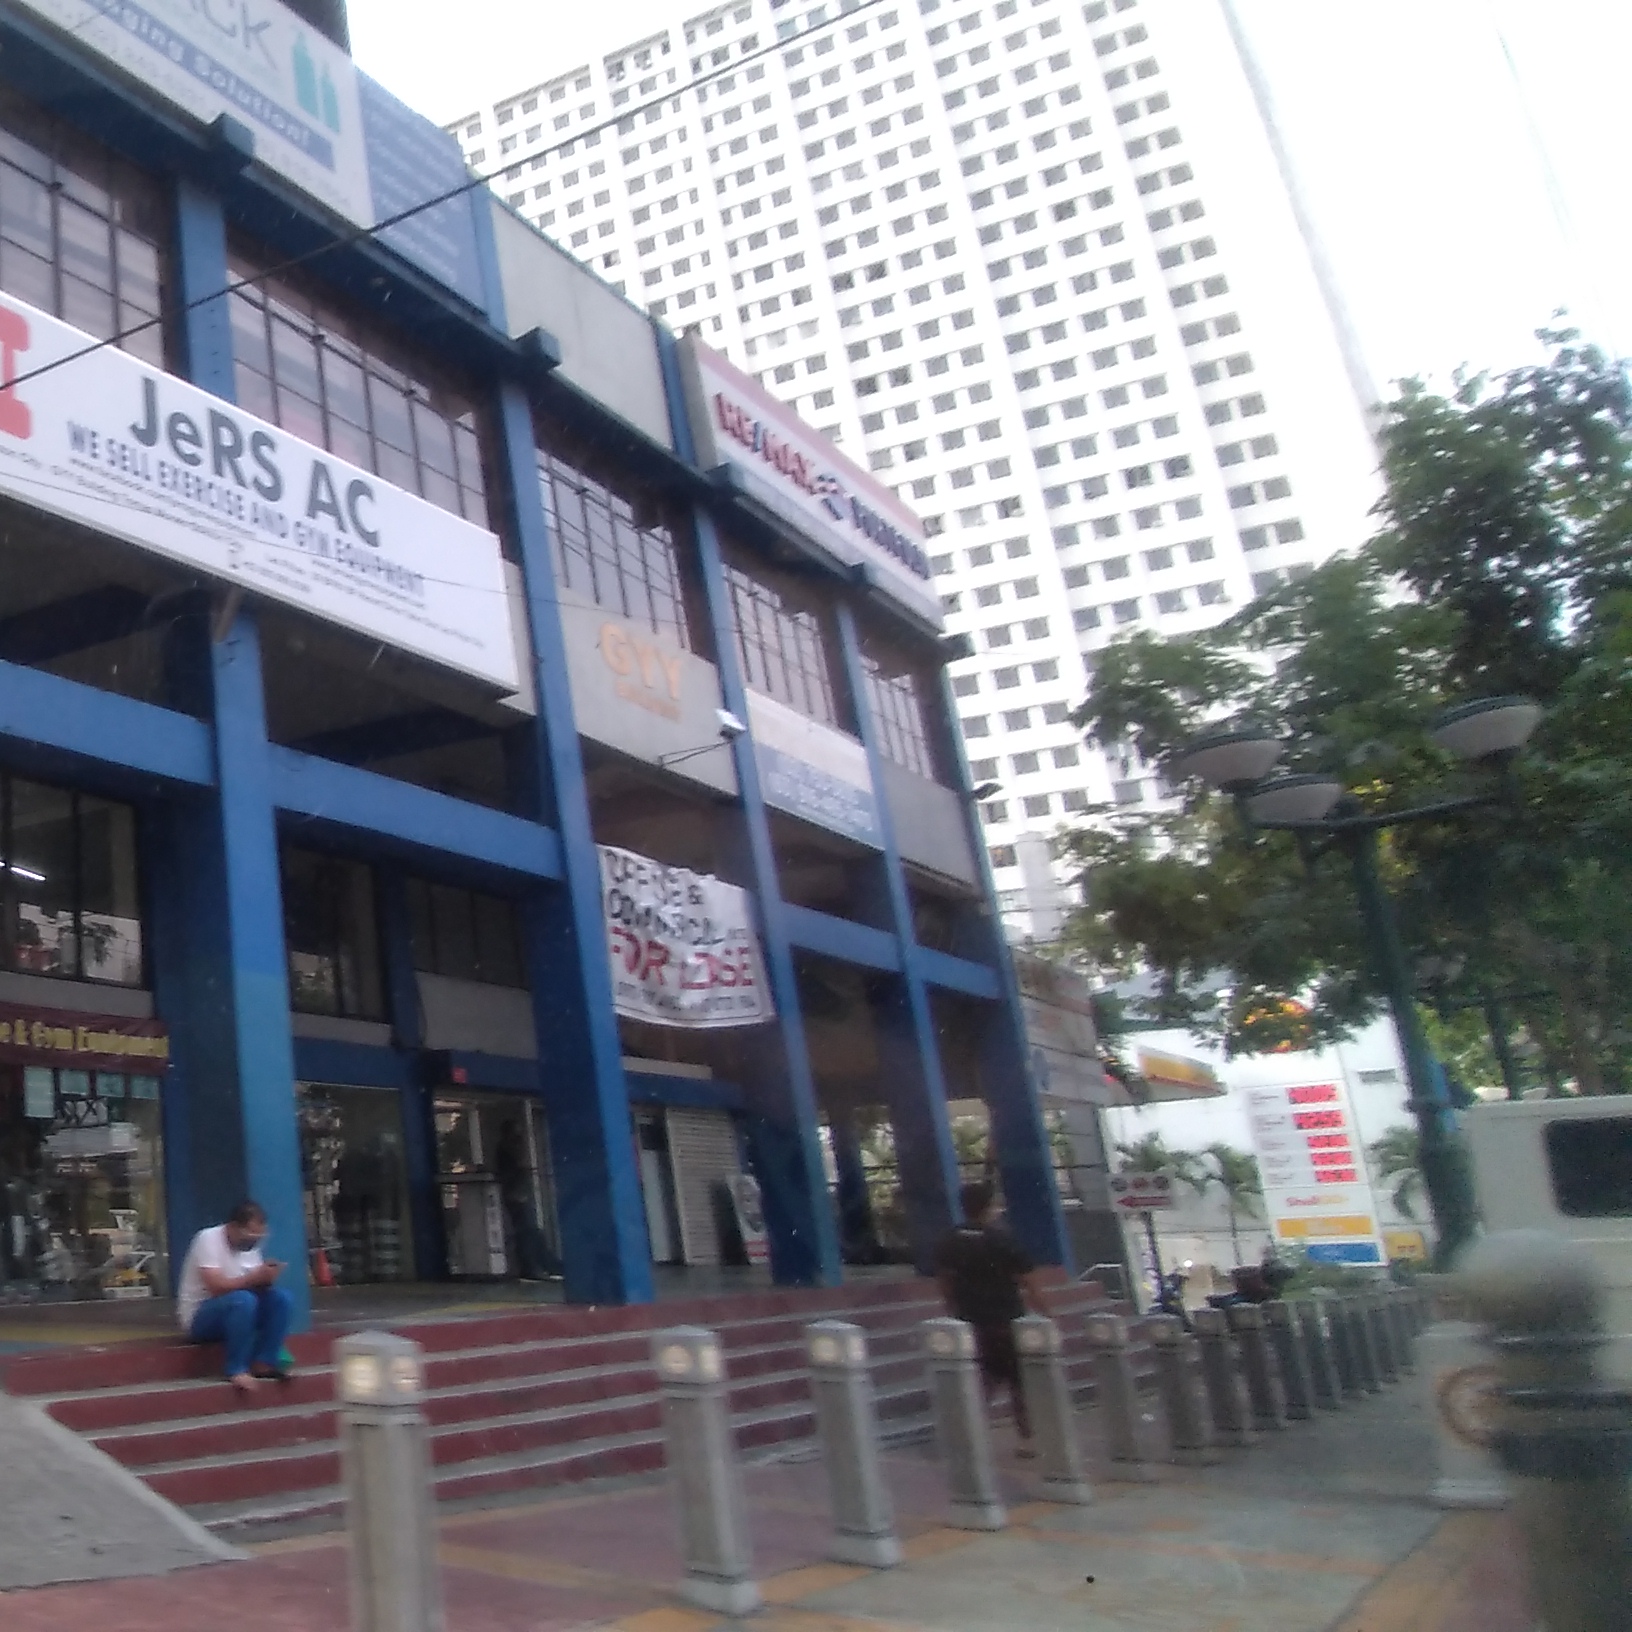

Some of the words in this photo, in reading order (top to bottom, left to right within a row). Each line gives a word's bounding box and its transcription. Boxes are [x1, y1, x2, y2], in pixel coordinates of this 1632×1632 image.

[66, 420, 100, 460] WE
[106, 437, 152, 482] SELL
[158, 460, 246, 522] EXERCISE
[251, 501, 289, 540] AND
[294, 520, 332, 558] GYM
[336, 537, 425, 598] EQUIPMENT
[129, 376, 284, 502] JeRS
[305, 458, 382, 549] AC
[598, 621, 683, 701] GYY
